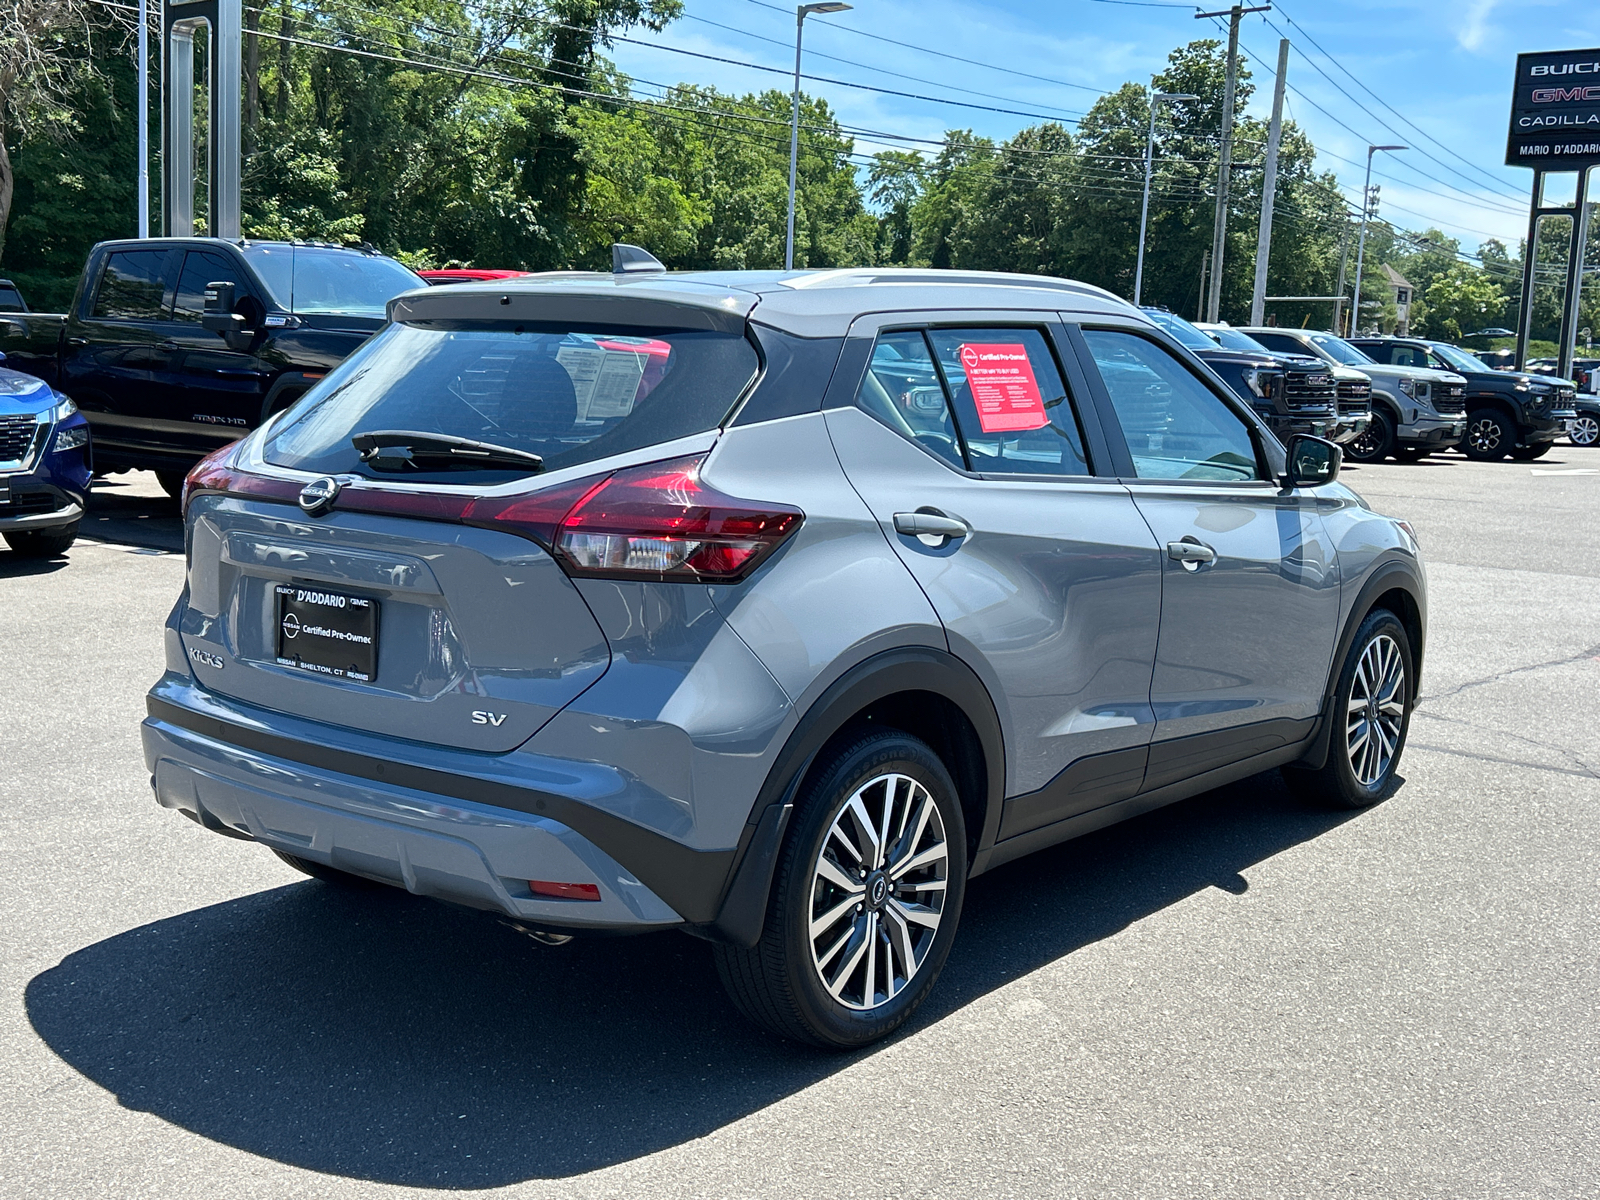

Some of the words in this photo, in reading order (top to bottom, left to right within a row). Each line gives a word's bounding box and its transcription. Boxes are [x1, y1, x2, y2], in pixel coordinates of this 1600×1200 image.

[1532, 86, 1600, 103] GMC
[1519, 114, 1600, 127] CADILLA
[1519, 145, 1550, 155] MARIO
[1554, 143, 1600, 155] D'ADDARI
[297, 590, 346, 608] D'ADDARIO
[350, 598, 369, 607] GMC
[302, 624, 331, 638] Certified
[190, 647, 224, 669] KICKS
[276, 657, 296, 667] NISSAN
[300, 662, 333, 674] SHELTON,
[334, 668, 344, 676] CT
[471, 710, 508, 727] SV
